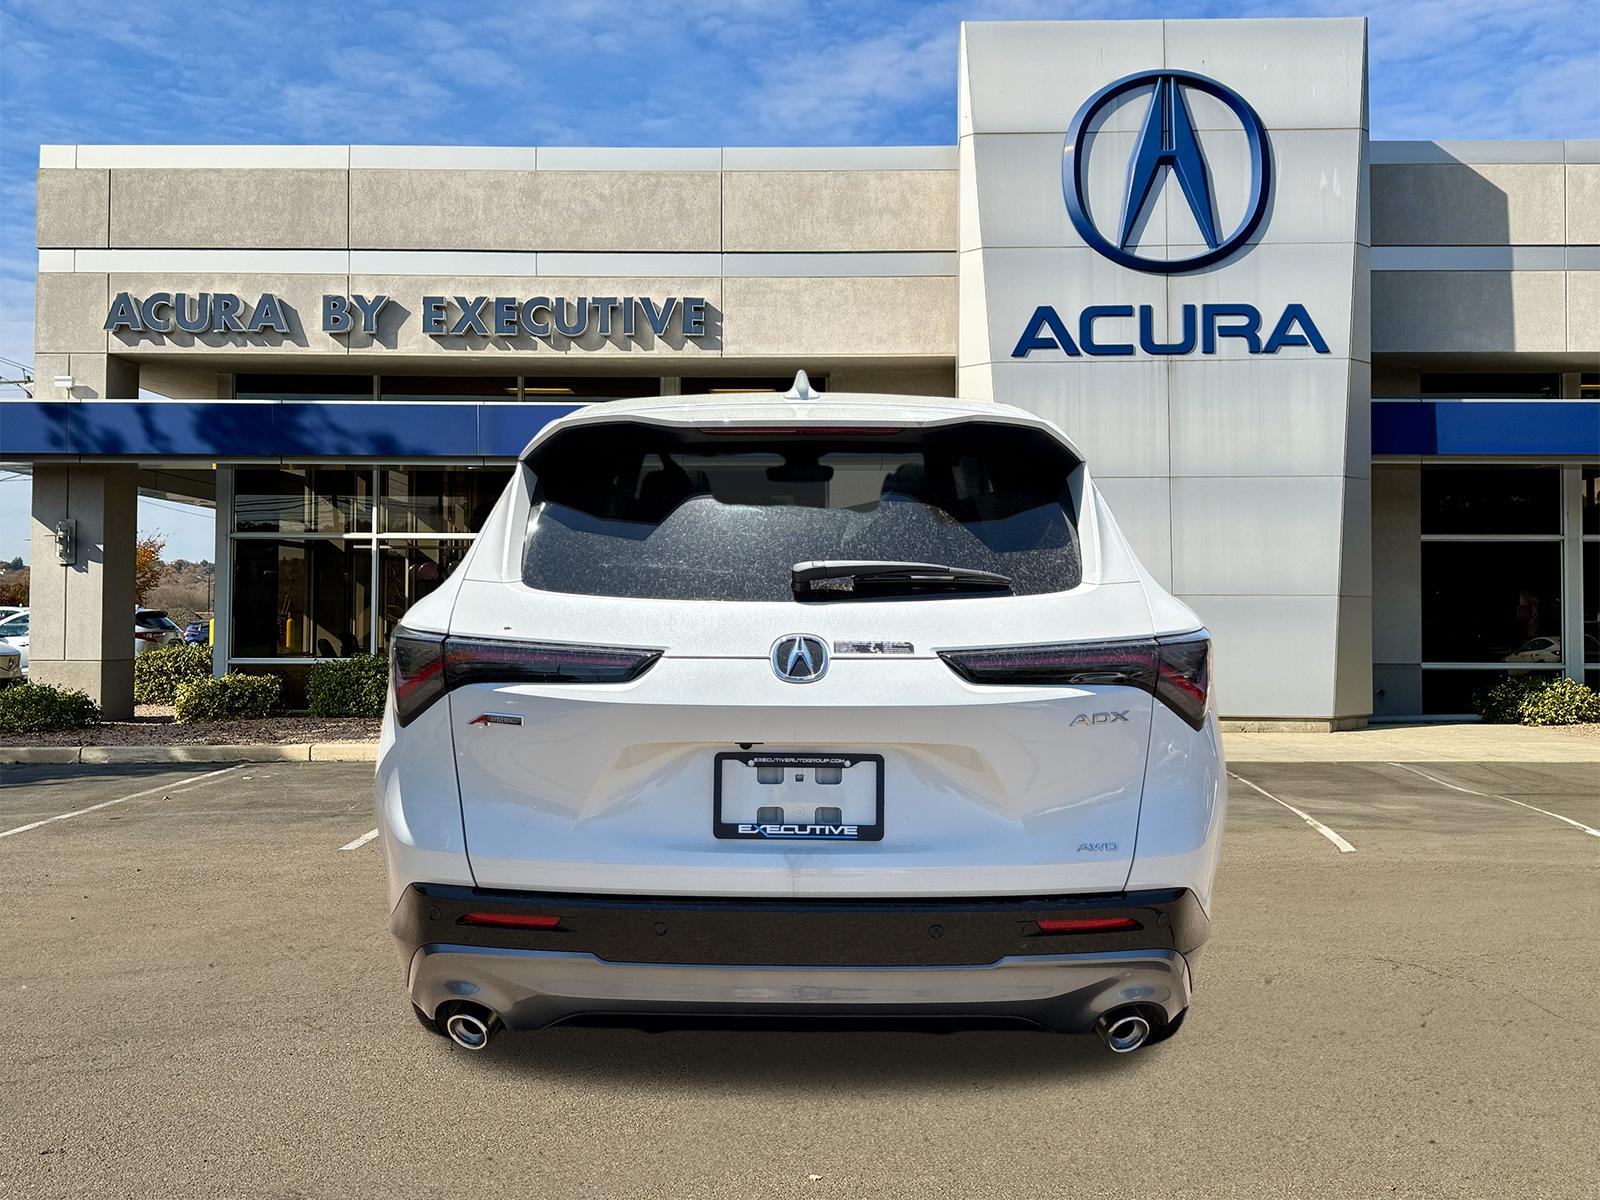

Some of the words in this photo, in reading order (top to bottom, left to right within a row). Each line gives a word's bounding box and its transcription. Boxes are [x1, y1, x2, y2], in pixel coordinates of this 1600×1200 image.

[103, 291, 290, 333] ACURA
[322, 294, 391, 334] BY
[422, 295, 706, 337] EXECUTIVE
[1010, 303, 1332, 357] ACURA
[1069, 710, 1130, 727] ADX
[738, 824, 858, 837] EXECUTIVE
[1076, 842, 1118, 852] AWD
